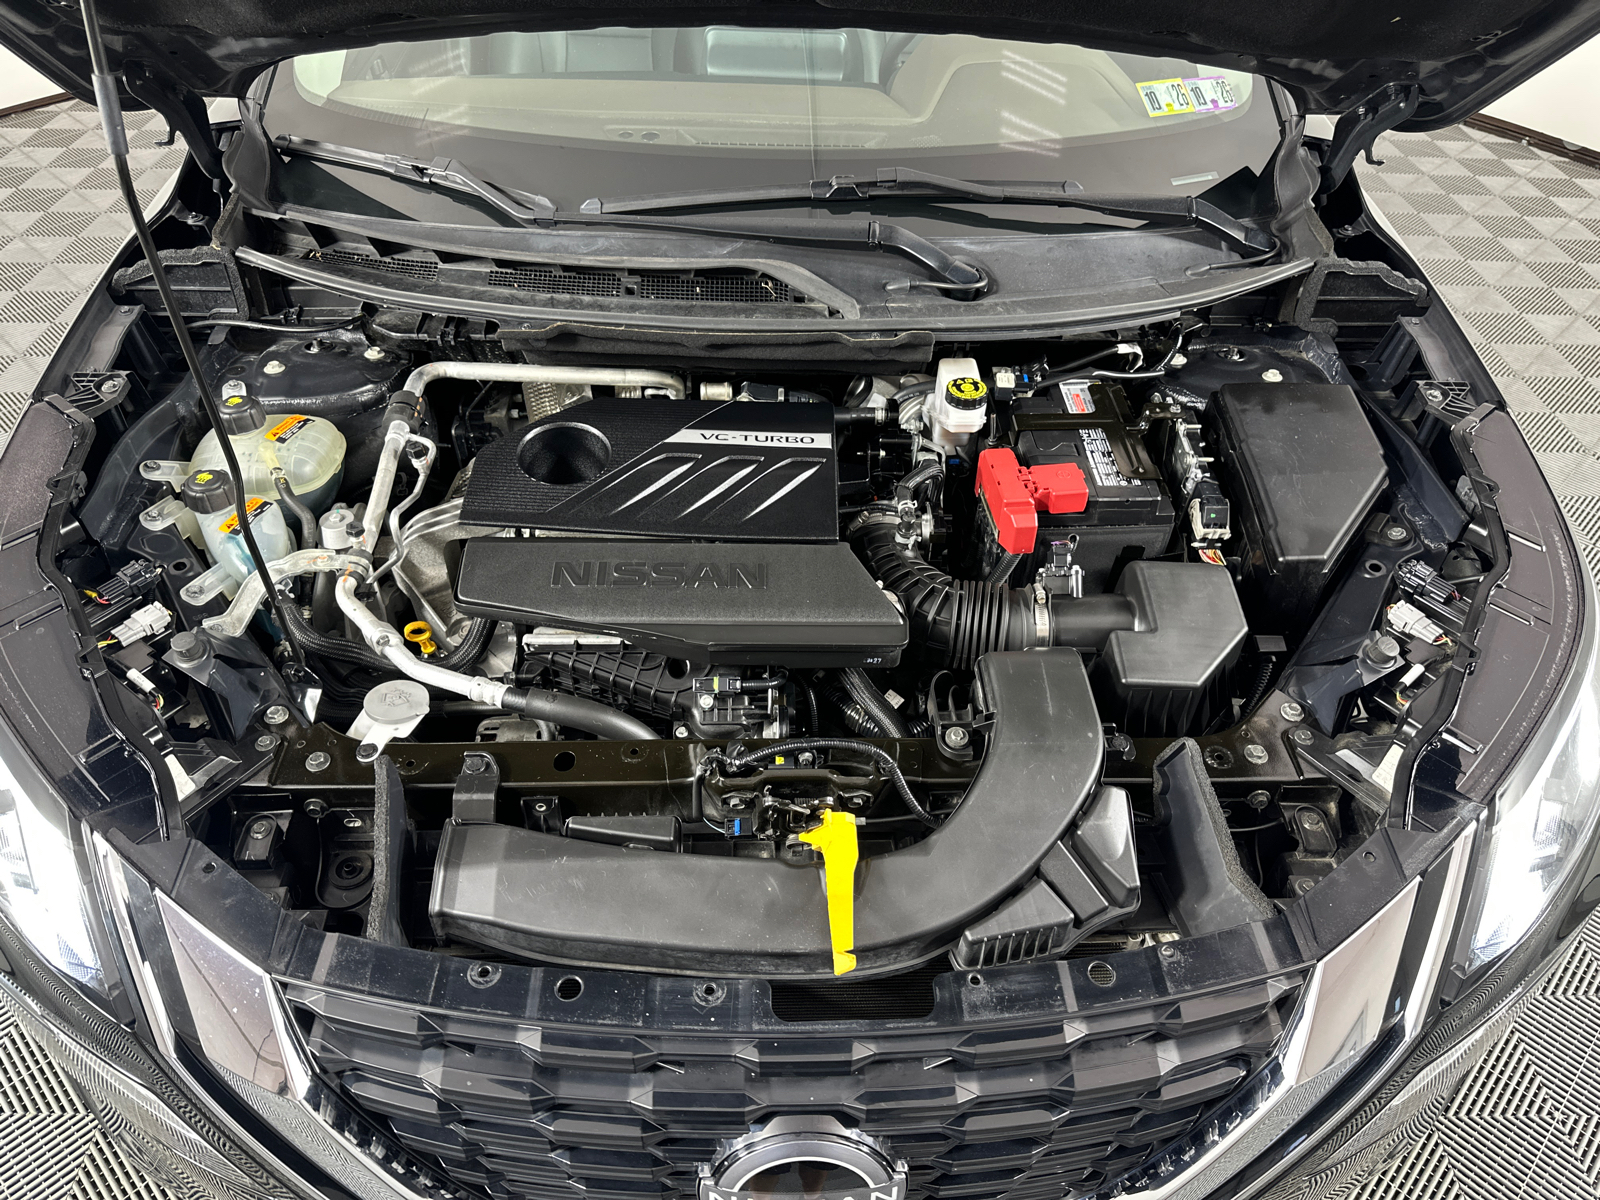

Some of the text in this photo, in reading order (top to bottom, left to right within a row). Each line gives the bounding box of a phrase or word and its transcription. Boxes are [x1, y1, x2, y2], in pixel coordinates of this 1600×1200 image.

[1144, 91, 1162, 111] 10
[1171, 83, 1190, 107] 26
[1190, 86, 1208, 106] 10
[1216, 80, 1234, 103] 26
[699, 432, 815, 445] VC-TURBO
[550, 560, 768, 589] NISSAN
